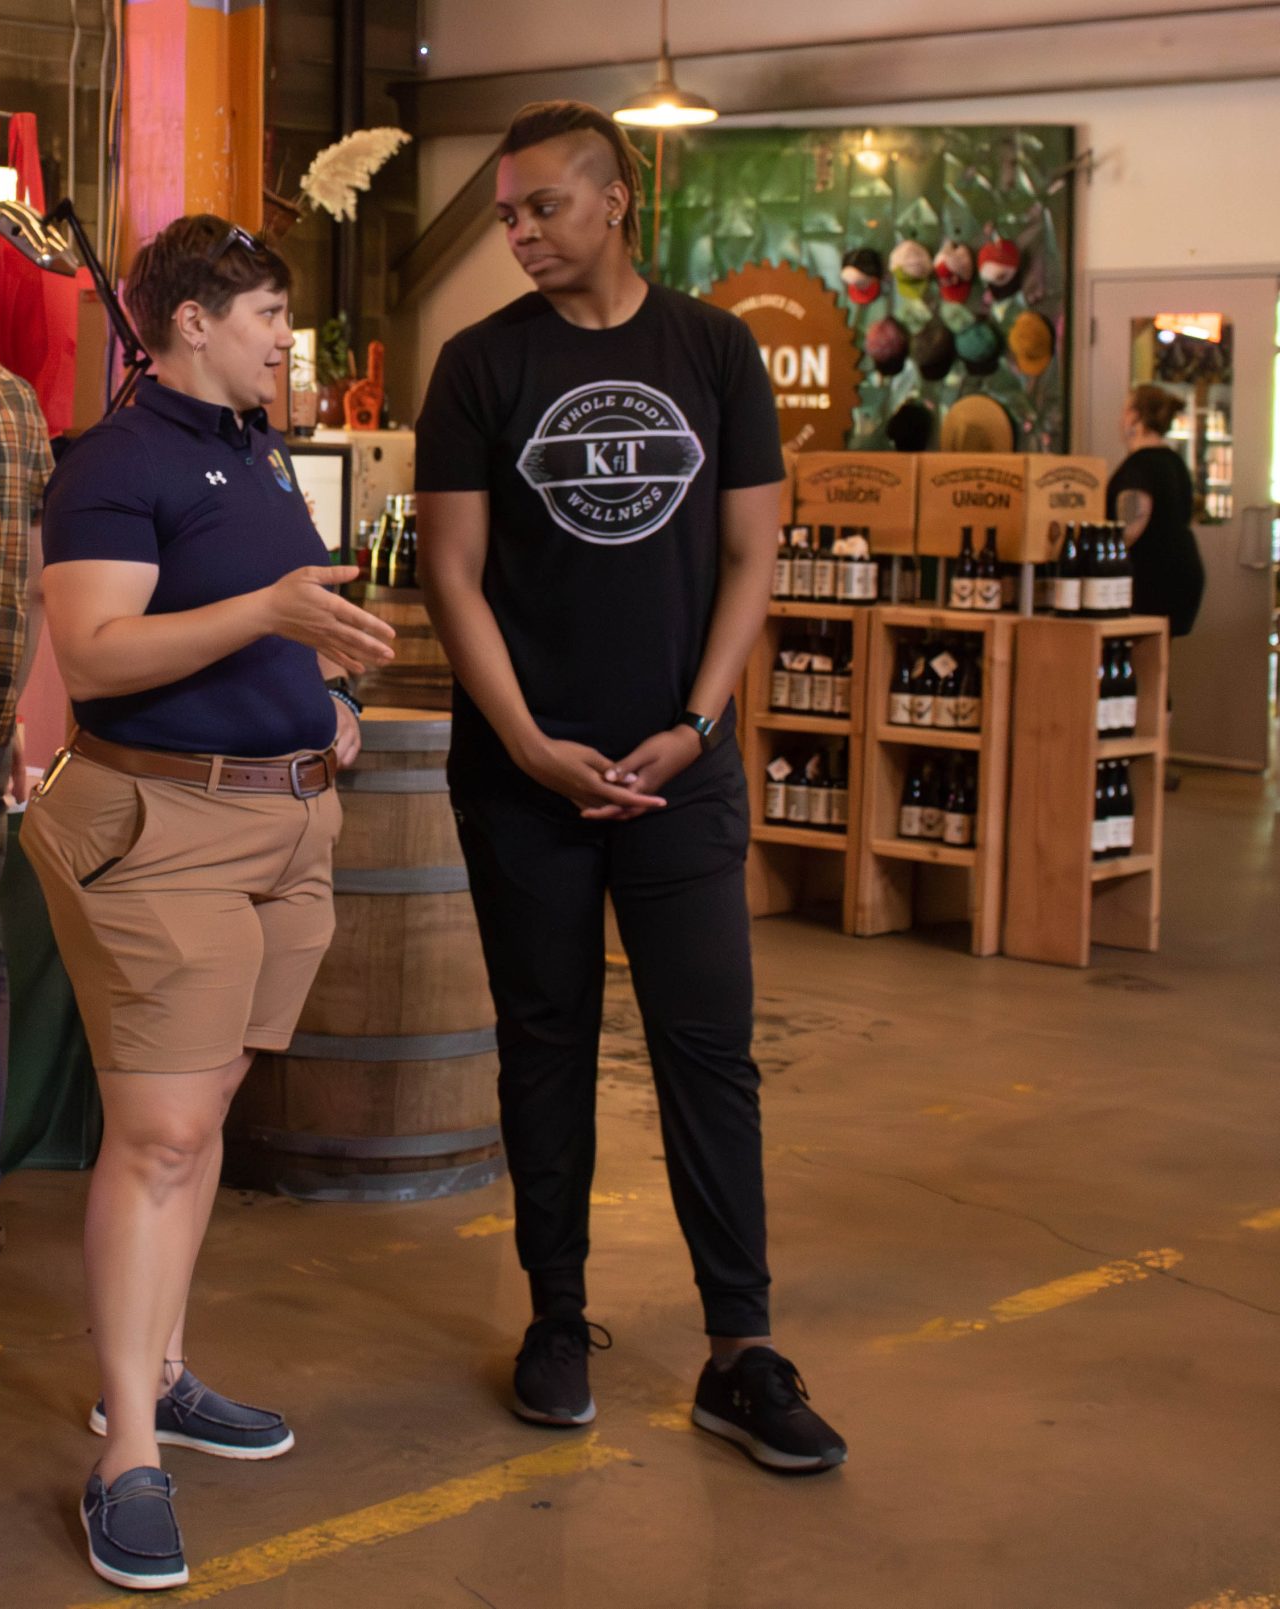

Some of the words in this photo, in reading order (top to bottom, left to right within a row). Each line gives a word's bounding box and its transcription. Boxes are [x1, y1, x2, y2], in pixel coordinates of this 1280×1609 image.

[558, 395, 616, 432] WHOLE
[622, 396, 670, 428] BODY
[567, 486, 663, 523] WELLNESS
[952, 490, 1011, 509] UNION
